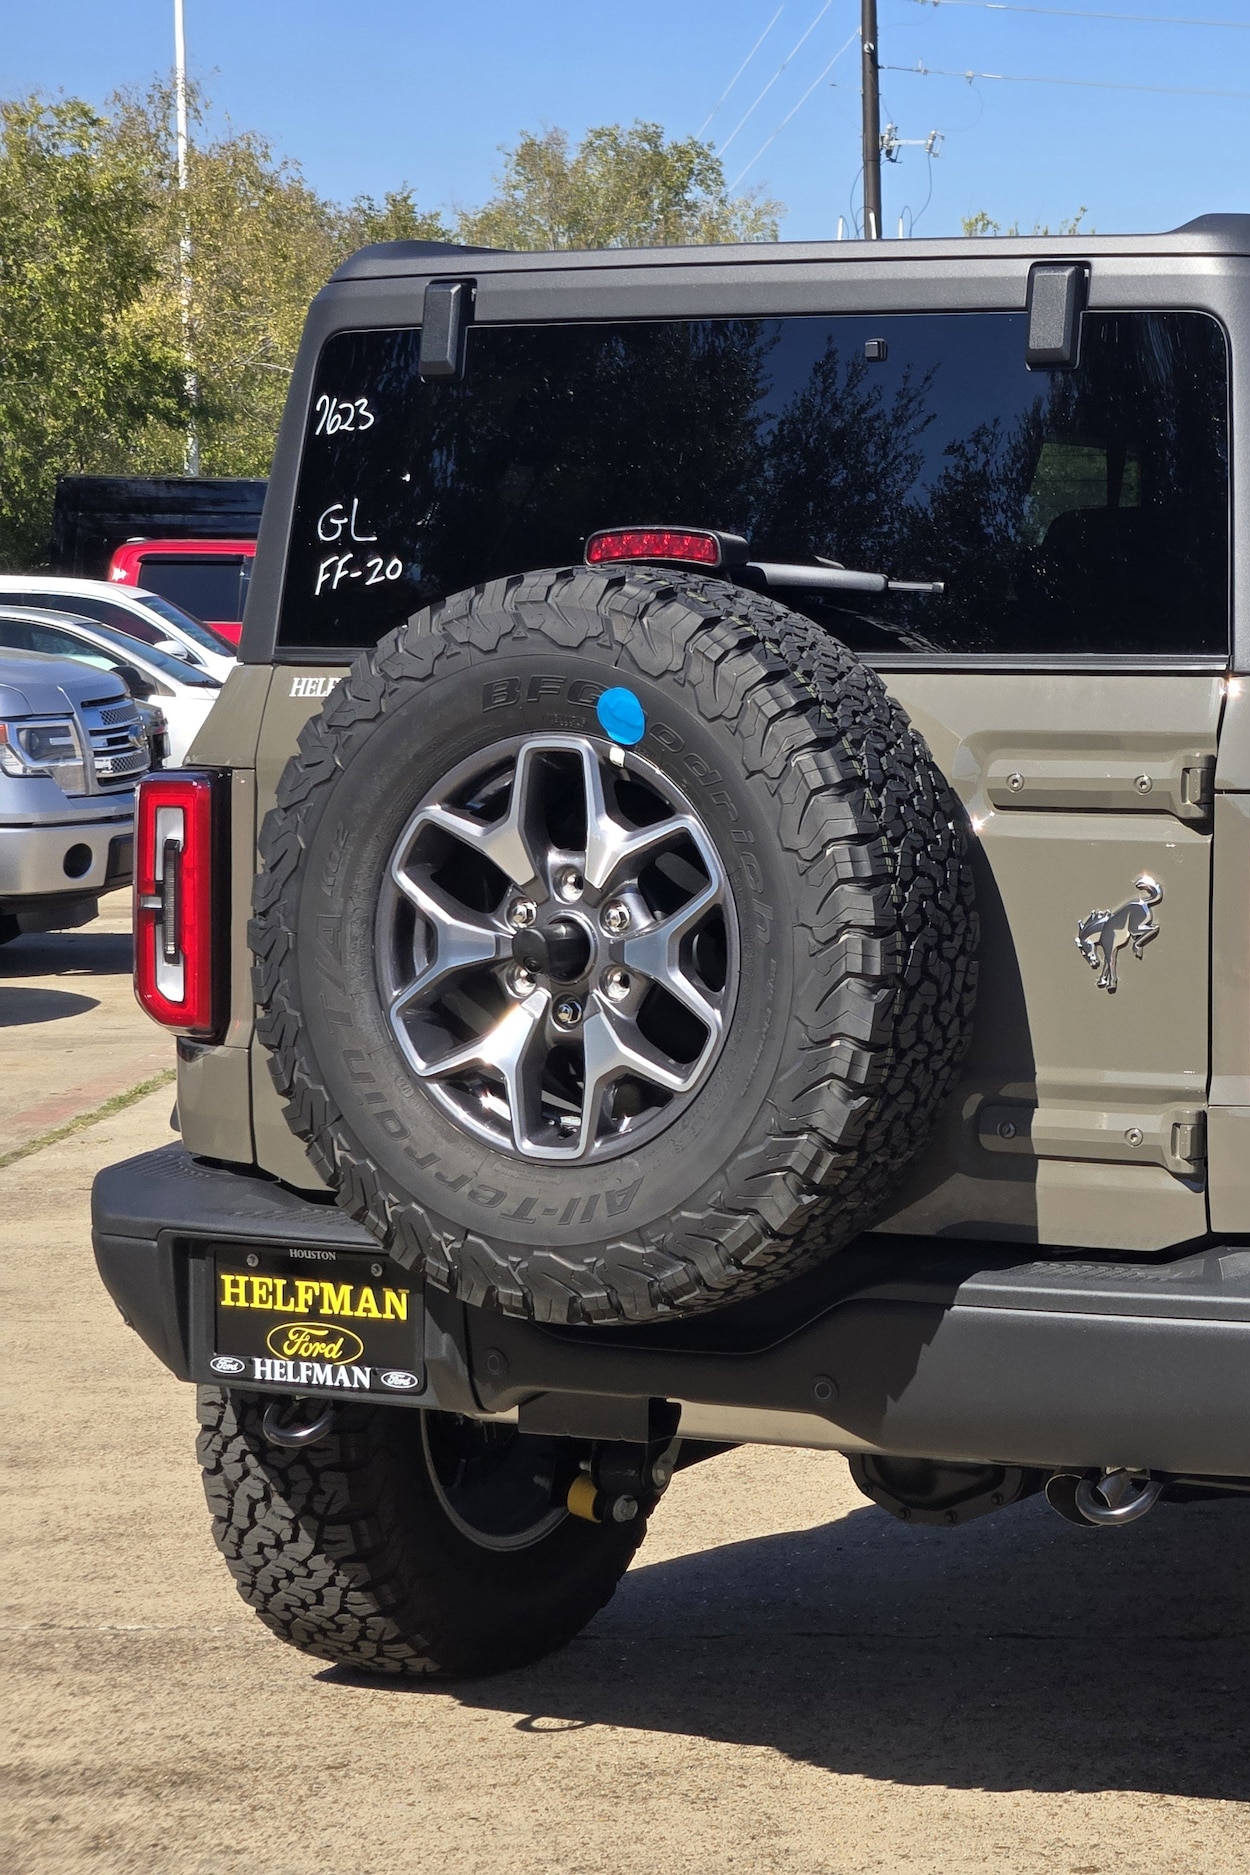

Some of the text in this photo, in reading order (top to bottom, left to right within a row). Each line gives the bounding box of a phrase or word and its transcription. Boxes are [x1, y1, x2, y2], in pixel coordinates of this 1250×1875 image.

[317, 498, 377, 541] GL
[314, 553, 402, 596] FF-20
[482, 674, 774, 945] BFGodrich
[289, 1248, 337, 1261] HOUSTON
[220, 1274, 410, 1321] HELFMAN
[283, 1326, 344, 1359] Ford
[252, 1357, 372, 1390] HELFMAN
